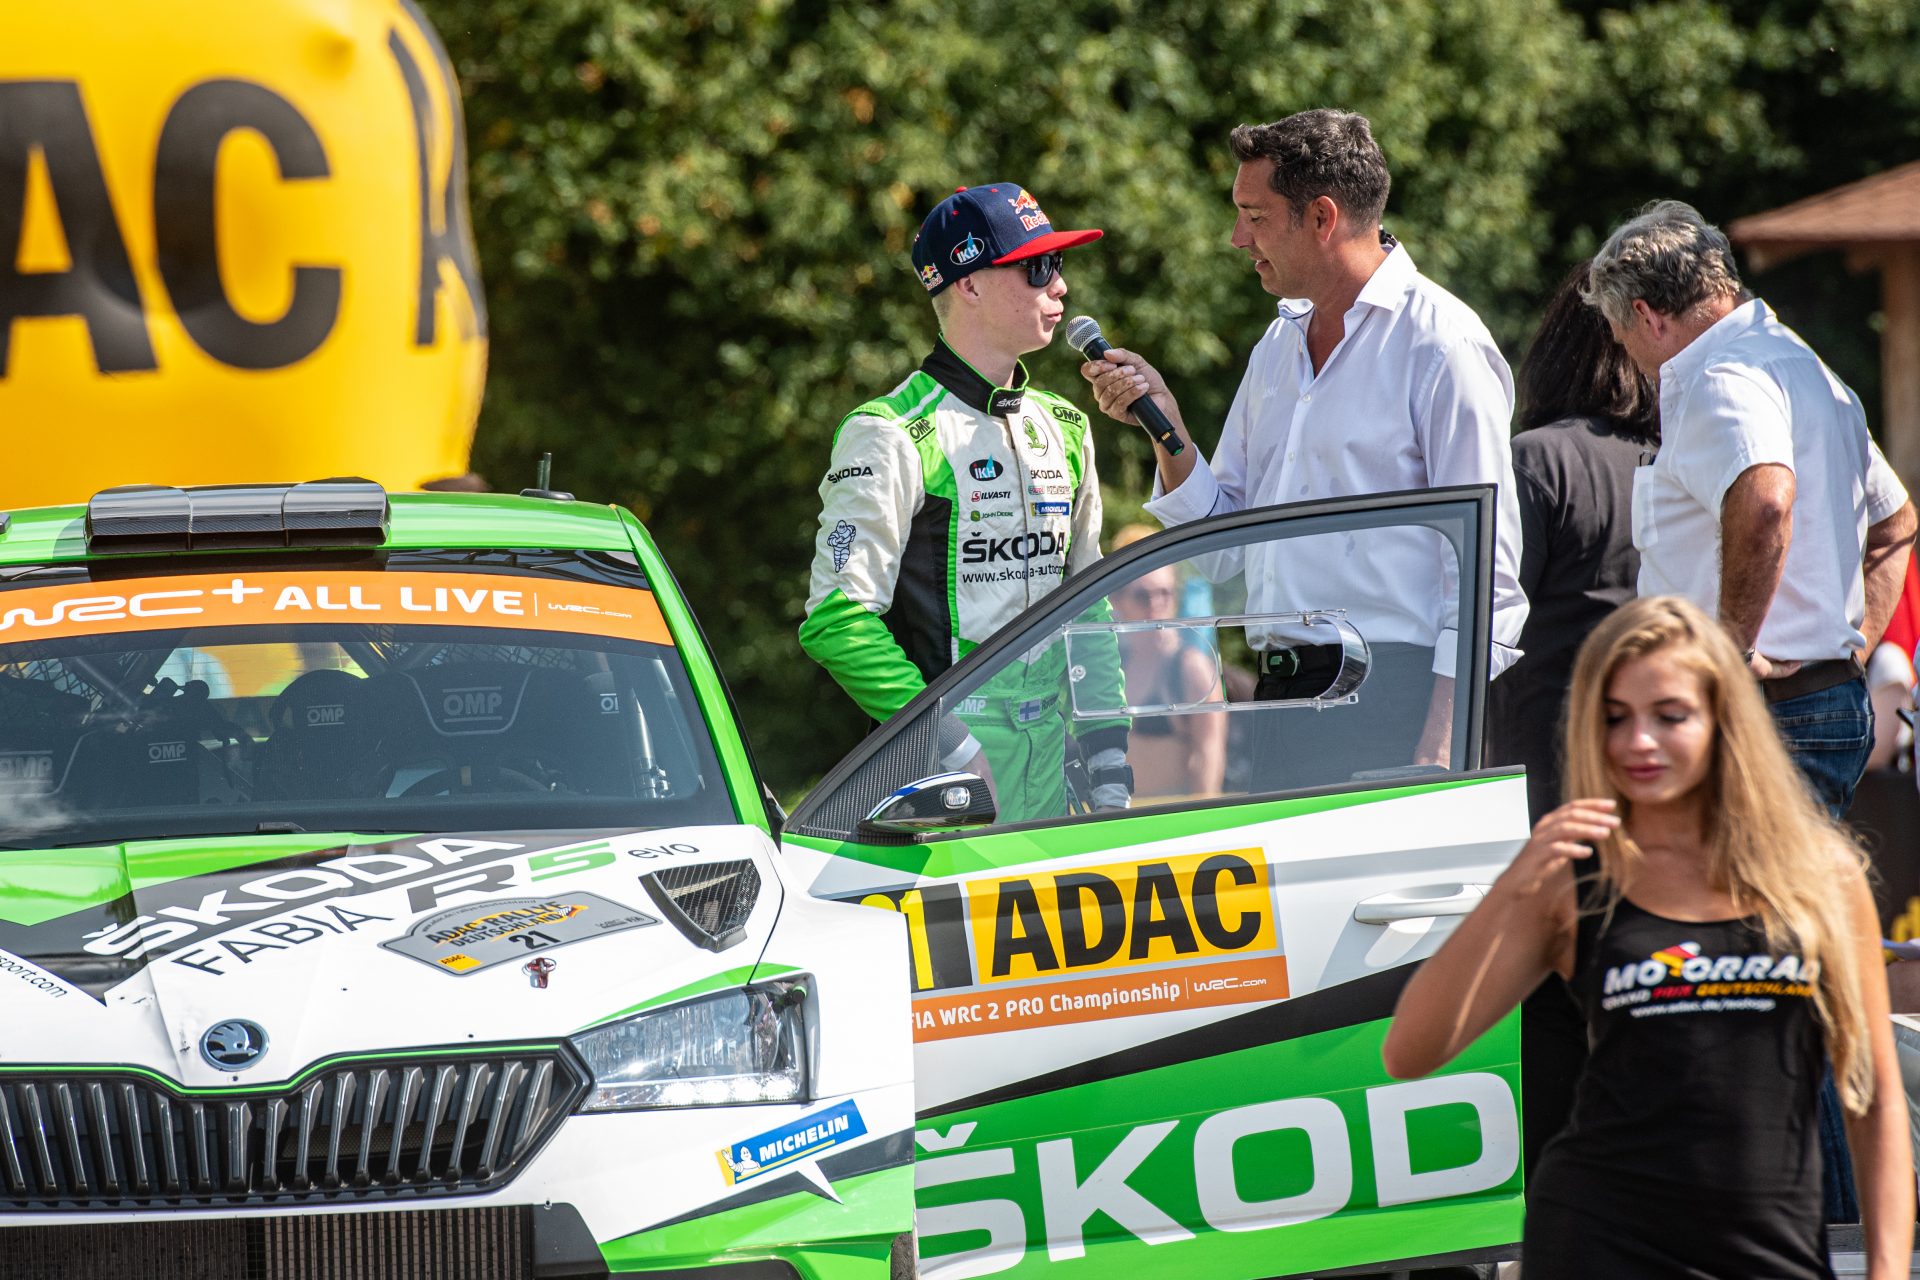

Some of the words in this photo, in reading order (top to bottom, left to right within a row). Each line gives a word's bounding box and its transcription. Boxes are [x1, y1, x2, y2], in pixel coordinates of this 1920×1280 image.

[909, 419, 931, 440] OMP
[1053, 406, 1082, 423] OMP
[971, 491, 1011, 502] SILVASTI
[962, 531, 1066, 564] ŠKODA
[273, 586, 382, 611] ALL
[400, 587, 524, 616] LIVE
[307, 707, 345, 723] OMP
[443, 691, 503, 716] OMP
[149, 744, 187, 760] OMP
[82, 838, 526, 960] ŠKODA
[171, 905, 395, 976] FABIA
[627, 843, 700, 860] evo
[425, 922, 488, 944] ADAC
[482, 901, 562, 926] RALLYE
[449, 911, 565, 947] DEUTSCHLAND
[991, 854, 1262, 977] ADAC
[508, 930, 562, 950] 21
[939, 1005, 982, 1028] WRC
[987, 1002, 1000, 1021] 2
[1005, 996, 1044, 1018] PRO
[1050, 980, 1181, 1012] Championship
[758, 1114, 849, 1162] MICHELIN
